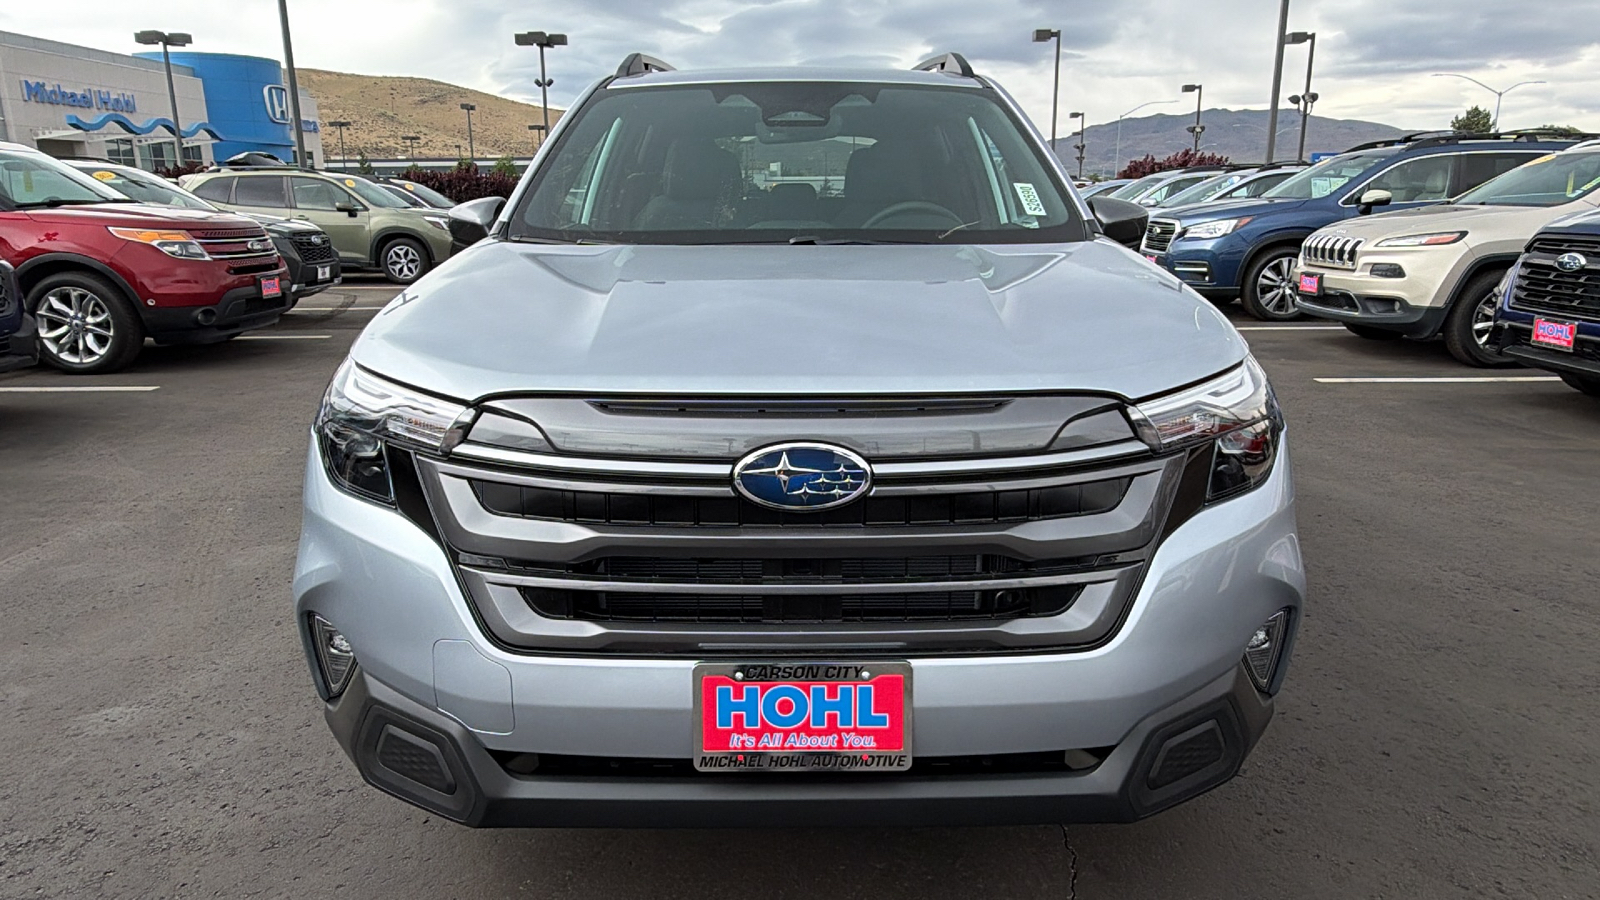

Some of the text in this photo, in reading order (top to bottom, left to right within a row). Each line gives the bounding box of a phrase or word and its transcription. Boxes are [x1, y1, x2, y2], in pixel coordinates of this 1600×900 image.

[21, 80, 136, 113] Michael Hohl
[1019, 186, 1042, 212] S26590
[1537, 322, 1571, 340] HOHL
[745, 666, 864, 679] CARSON CITY
[716, 684, 889, 728] HOHL
[729, 733, 877, 747] It's All About You.
[699, 754, 907, 768] MICHAEL HOHL AUTOMOTIVE
